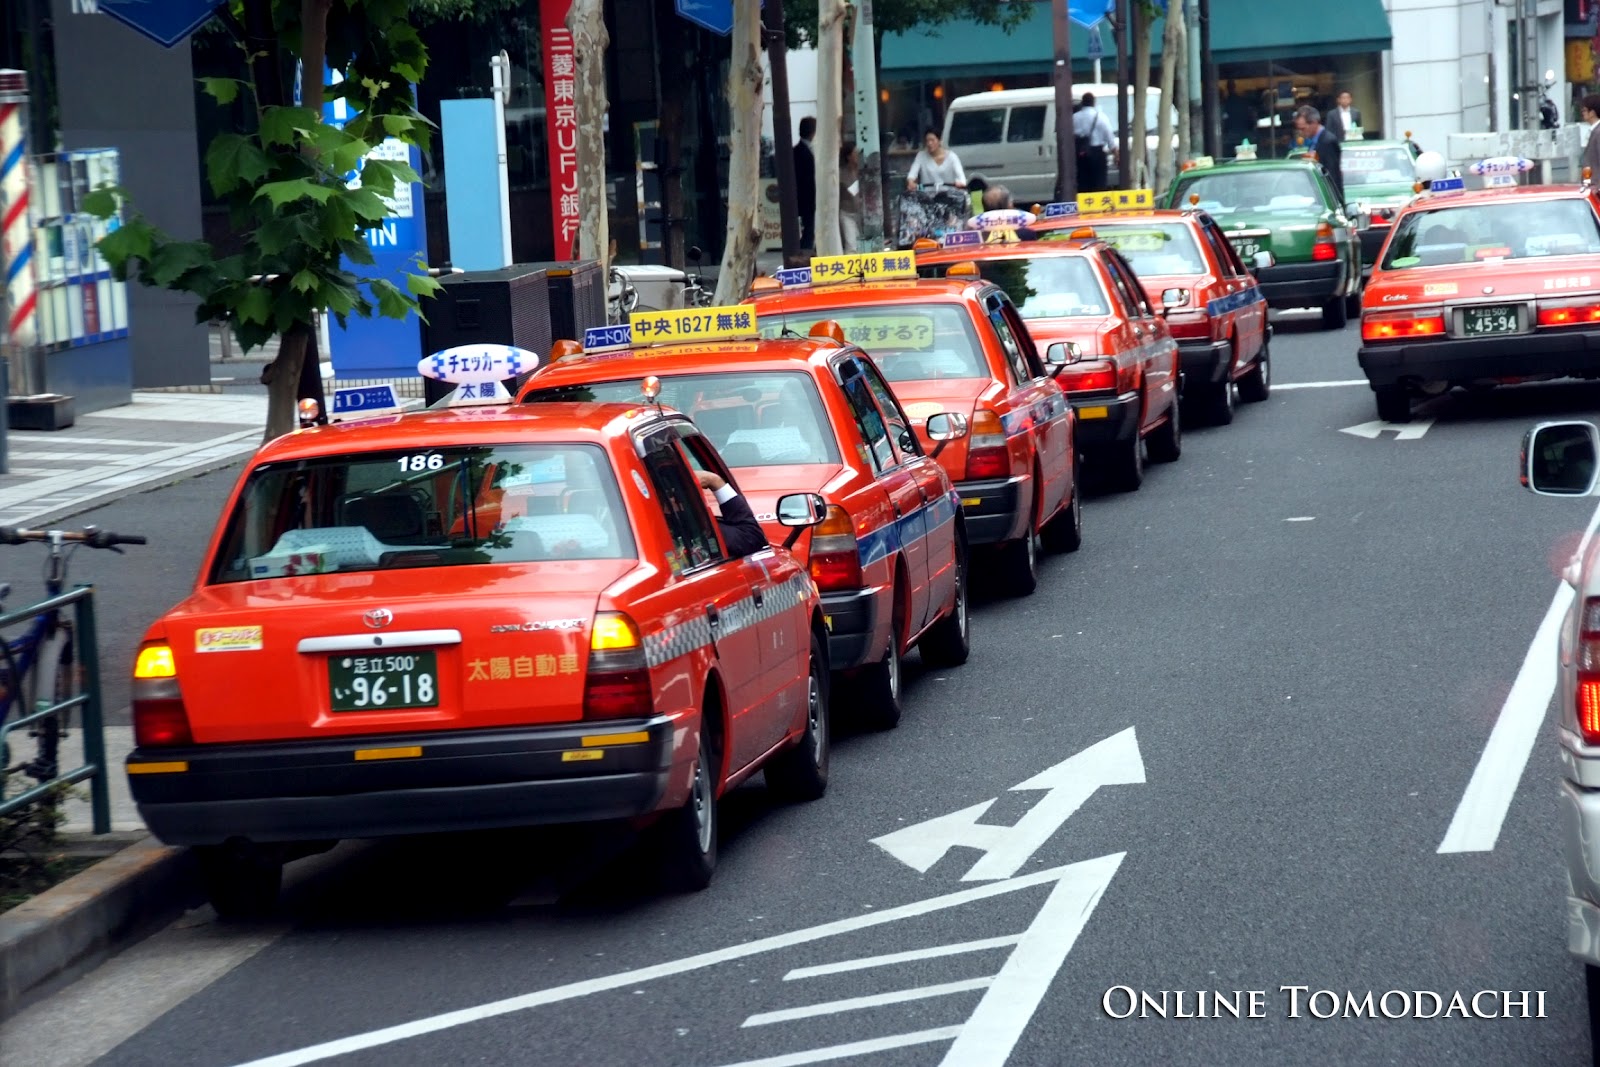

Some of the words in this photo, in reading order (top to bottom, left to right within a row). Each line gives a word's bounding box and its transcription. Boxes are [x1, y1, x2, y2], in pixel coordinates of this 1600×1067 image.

[550, 28, 580, 242] 三菱東京UFJ銀行
[635, 318, 672, 337] 中央
[675, 315, 712, 334] 1627
[716, 311, 751, 331] 無線
[1475, 315, 1517, 332] 45-94
[448, 351, 502, 373] チェッカー
[460, 382, 497, 400] 太陽
[397, 453, 444, 472] 186
[467, 653, 581, 682] 太陽自動車
[351, 672, 434, 707] 96-18
